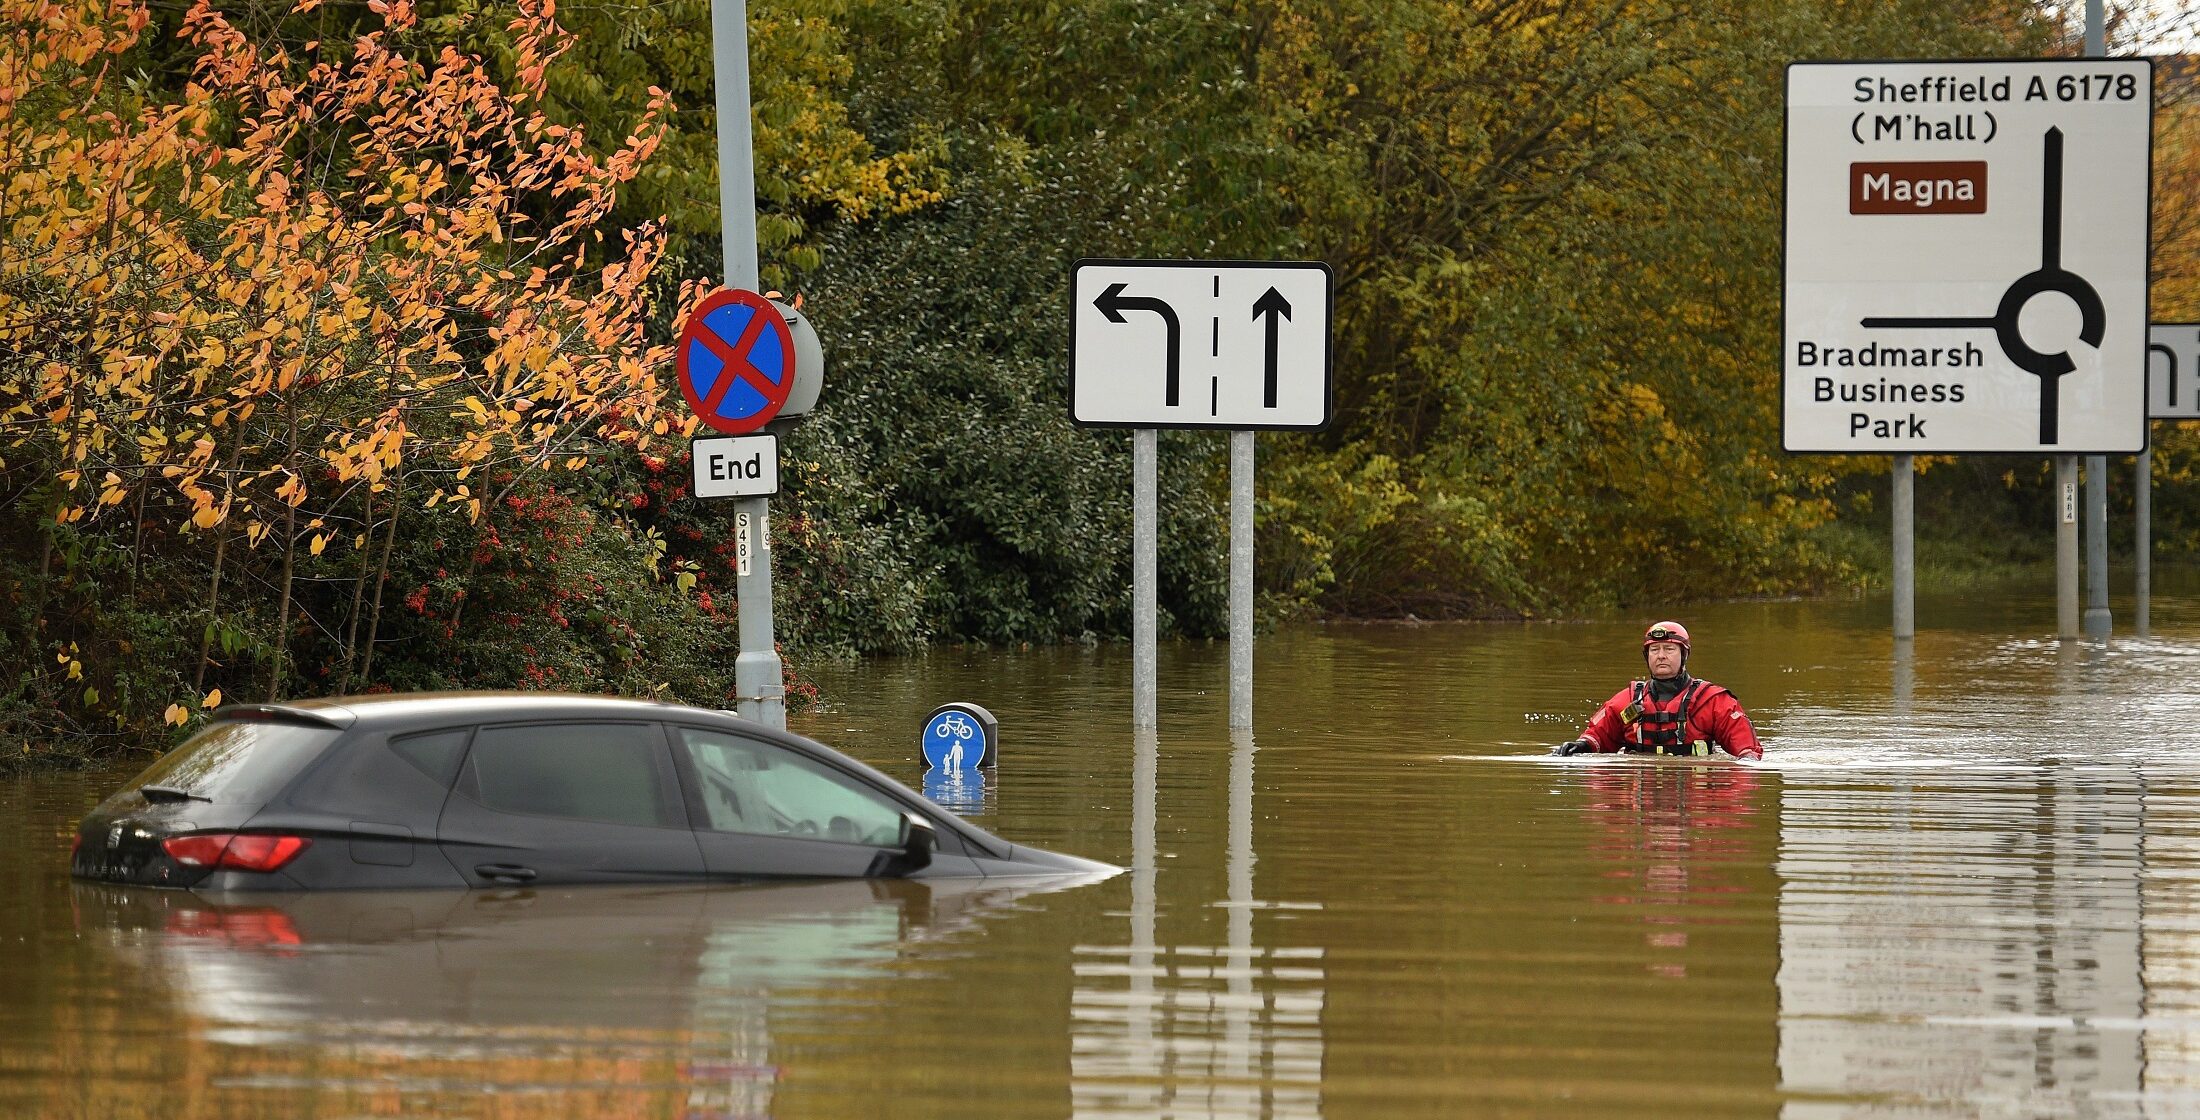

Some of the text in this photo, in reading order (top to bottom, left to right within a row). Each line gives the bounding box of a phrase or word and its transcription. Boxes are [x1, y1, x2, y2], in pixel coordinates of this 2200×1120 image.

[1853, 73, 2137, 103] Sheffield A 6178
[1851, 110, 1998, 145] (M'hall)
[1863, 173, 1974, 207] Magna
[1797, 341, 1984, 367] Bradmarsh
[1814, 377, 1965, 403] Business
[1850, 412, 1927, 439] Park
[709, 452, 761, 481] End
[738, 513, 748, 572] S481
